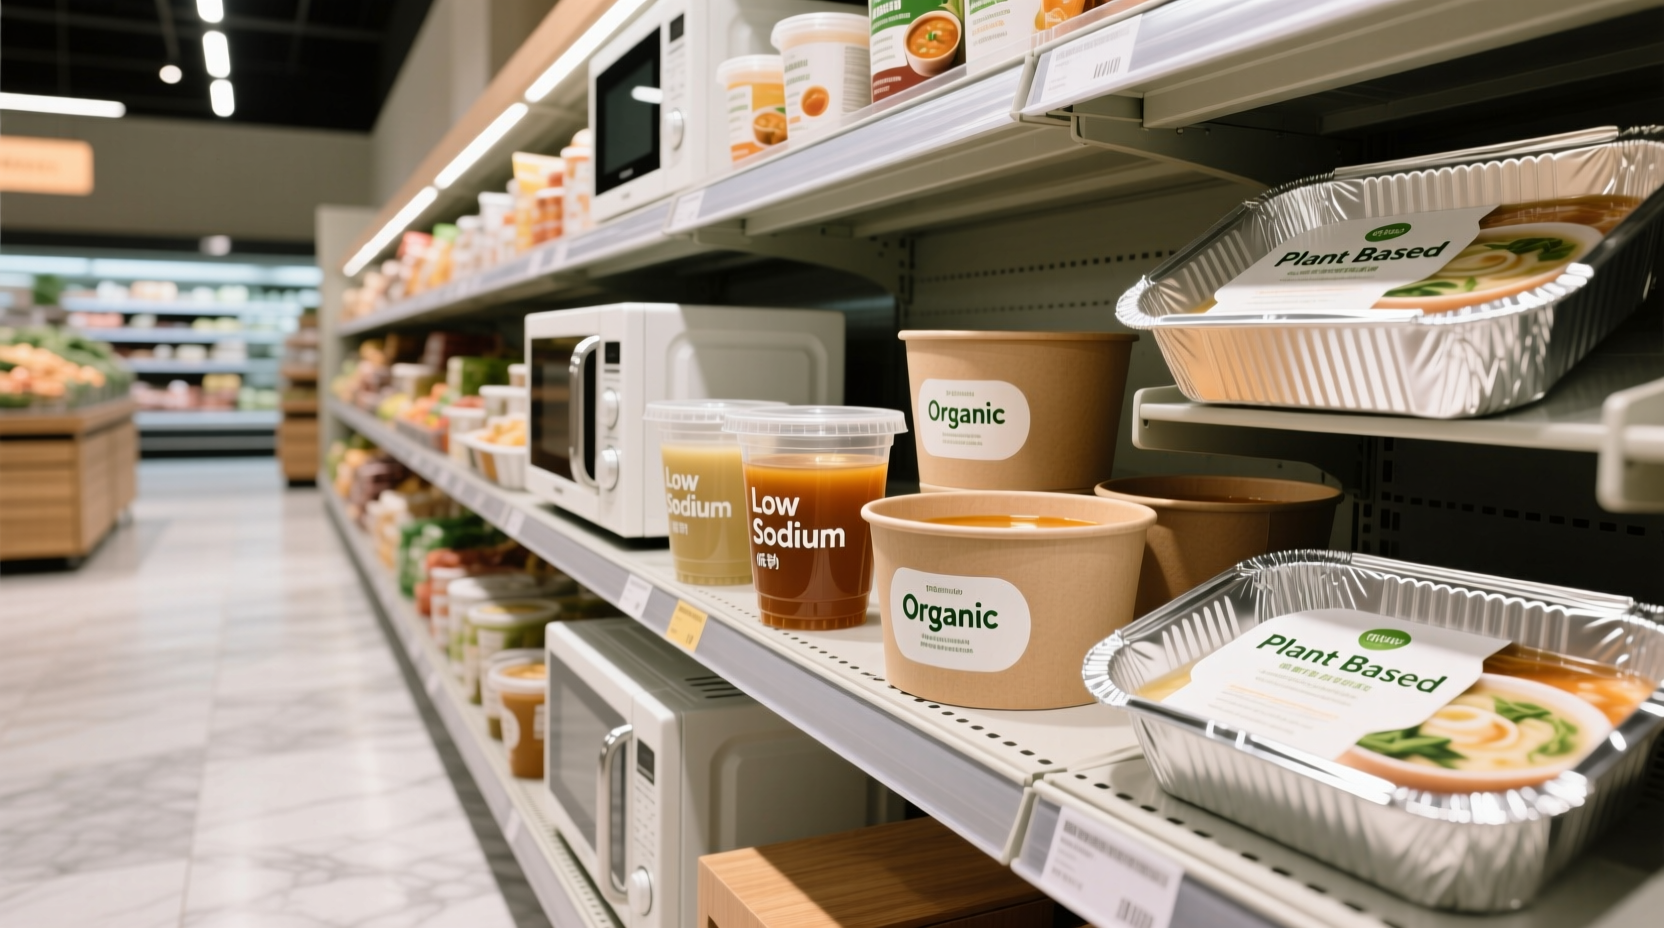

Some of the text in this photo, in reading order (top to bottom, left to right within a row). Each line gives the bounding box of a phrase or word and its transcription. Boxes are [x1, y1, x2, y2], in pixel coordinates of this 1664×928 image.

[1275, 241, 1450, 267] Plant Based
[928, 399, 1006, 430] Organic
[665, 466, 699, 491] Low
[666, 493, 732, 518] Sodium
[751, 487, 800, 517] Low
[752, 518, 845, 550] Sodium
[902, 593, 999, 632] Organic
[1256, 633, 1340, 666] Plant
[1339, 655, 1448, 693] Based
